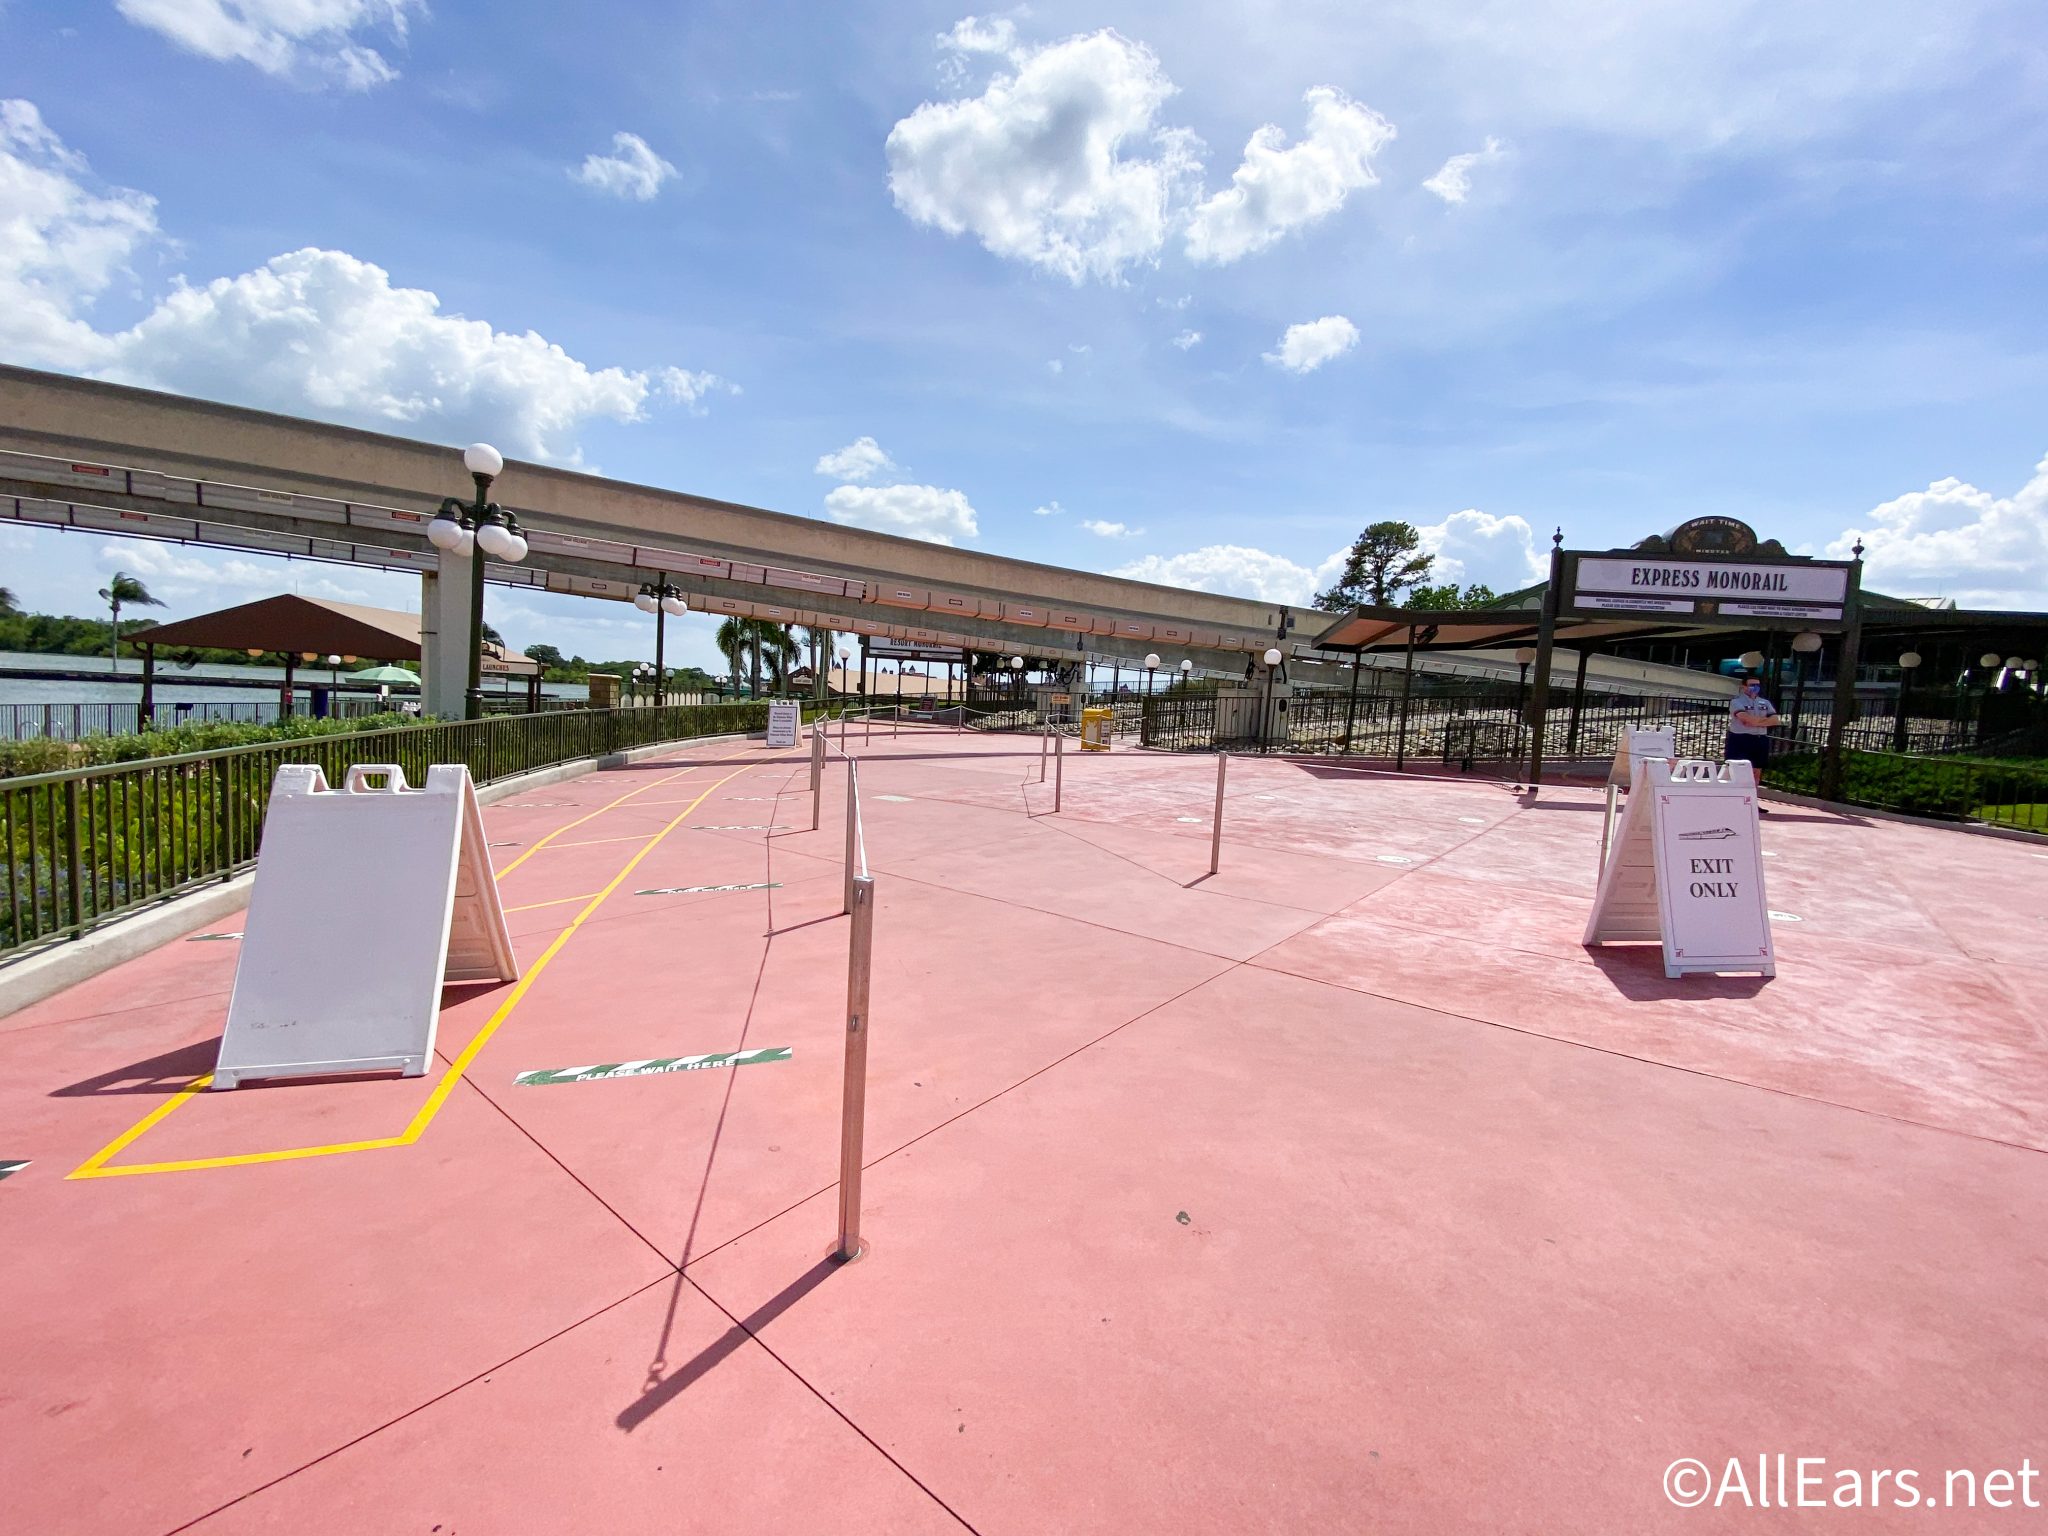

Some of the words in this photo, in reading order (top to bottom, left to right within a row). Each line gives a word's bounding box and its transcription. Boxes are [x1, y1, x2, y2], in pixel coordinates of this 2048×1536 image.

[1691, 519, 1715, 528] WAIT
[1719, 518, 1742, 529] TIME
[1631, 567, 1700, 588] EXPRESS
[1706, 570, 1788, 592] MONORAIL
[1689, 858, 1734, 874] EXIT
[1689, 882, 1739, 898] ONLY
[576, 1069, 640, 1081] PLEASE
[640, 1064, 682, 1075] WAIT
[687, 1059, 736, 1070] HERE
